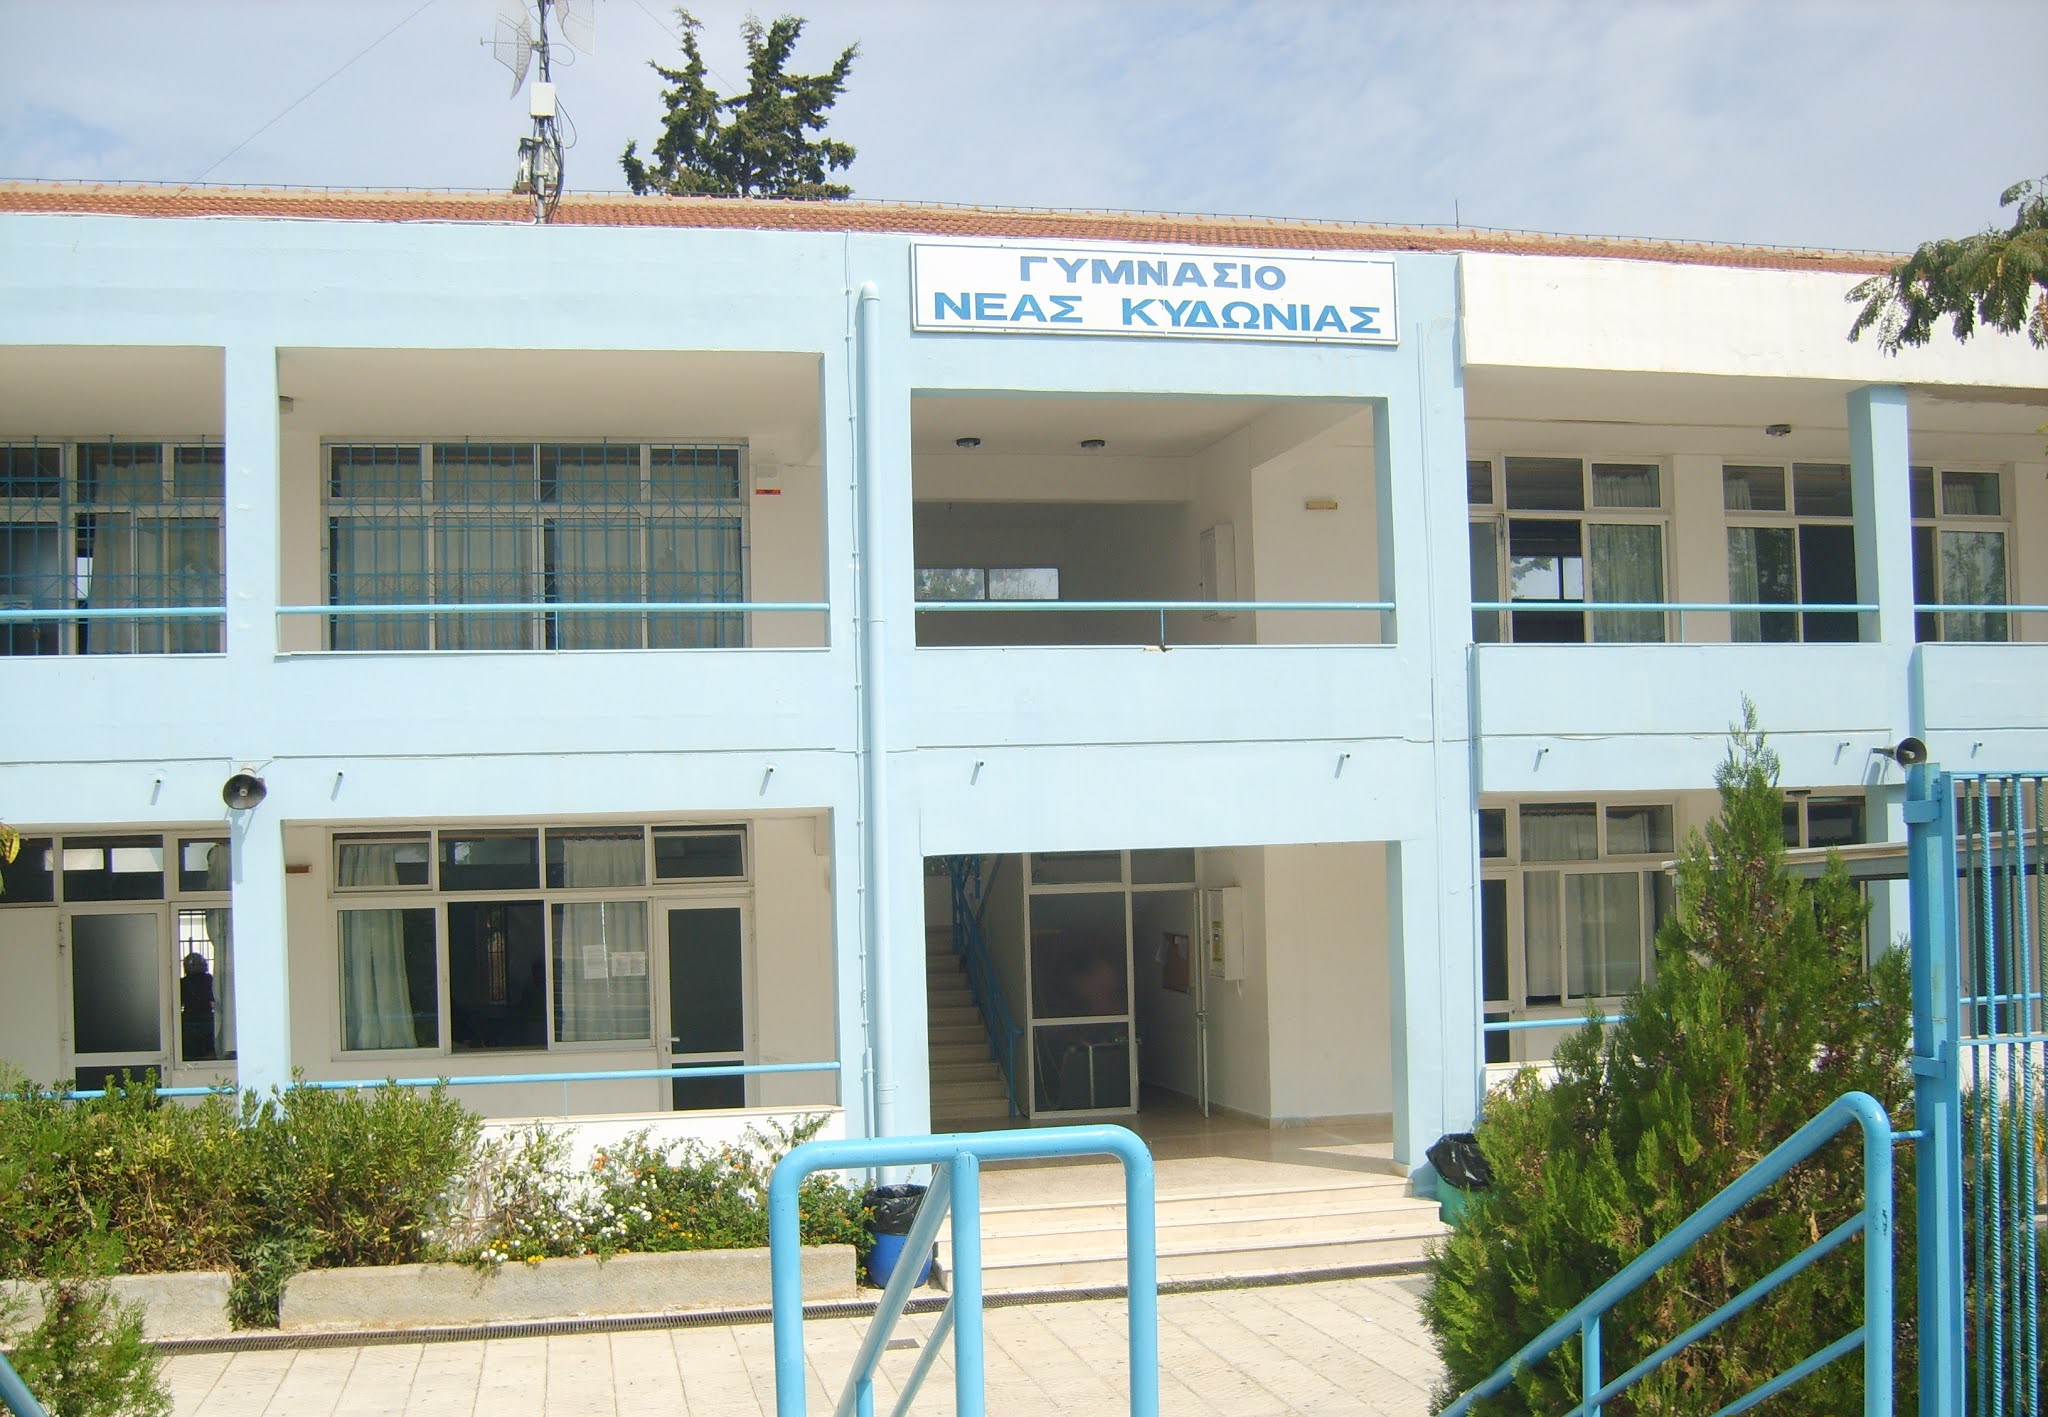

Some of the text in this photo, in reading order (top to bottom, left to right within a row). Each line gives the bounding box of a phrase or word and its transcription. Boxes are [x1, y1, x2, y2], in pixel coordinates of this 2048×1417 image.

[1020, 256, 1286, 291] ΓΥΜΝΑΣΙΟ
[934, 292, 1381, 335] ΝΕΑΣ ΚΥΔΩΝΙΑΣ
